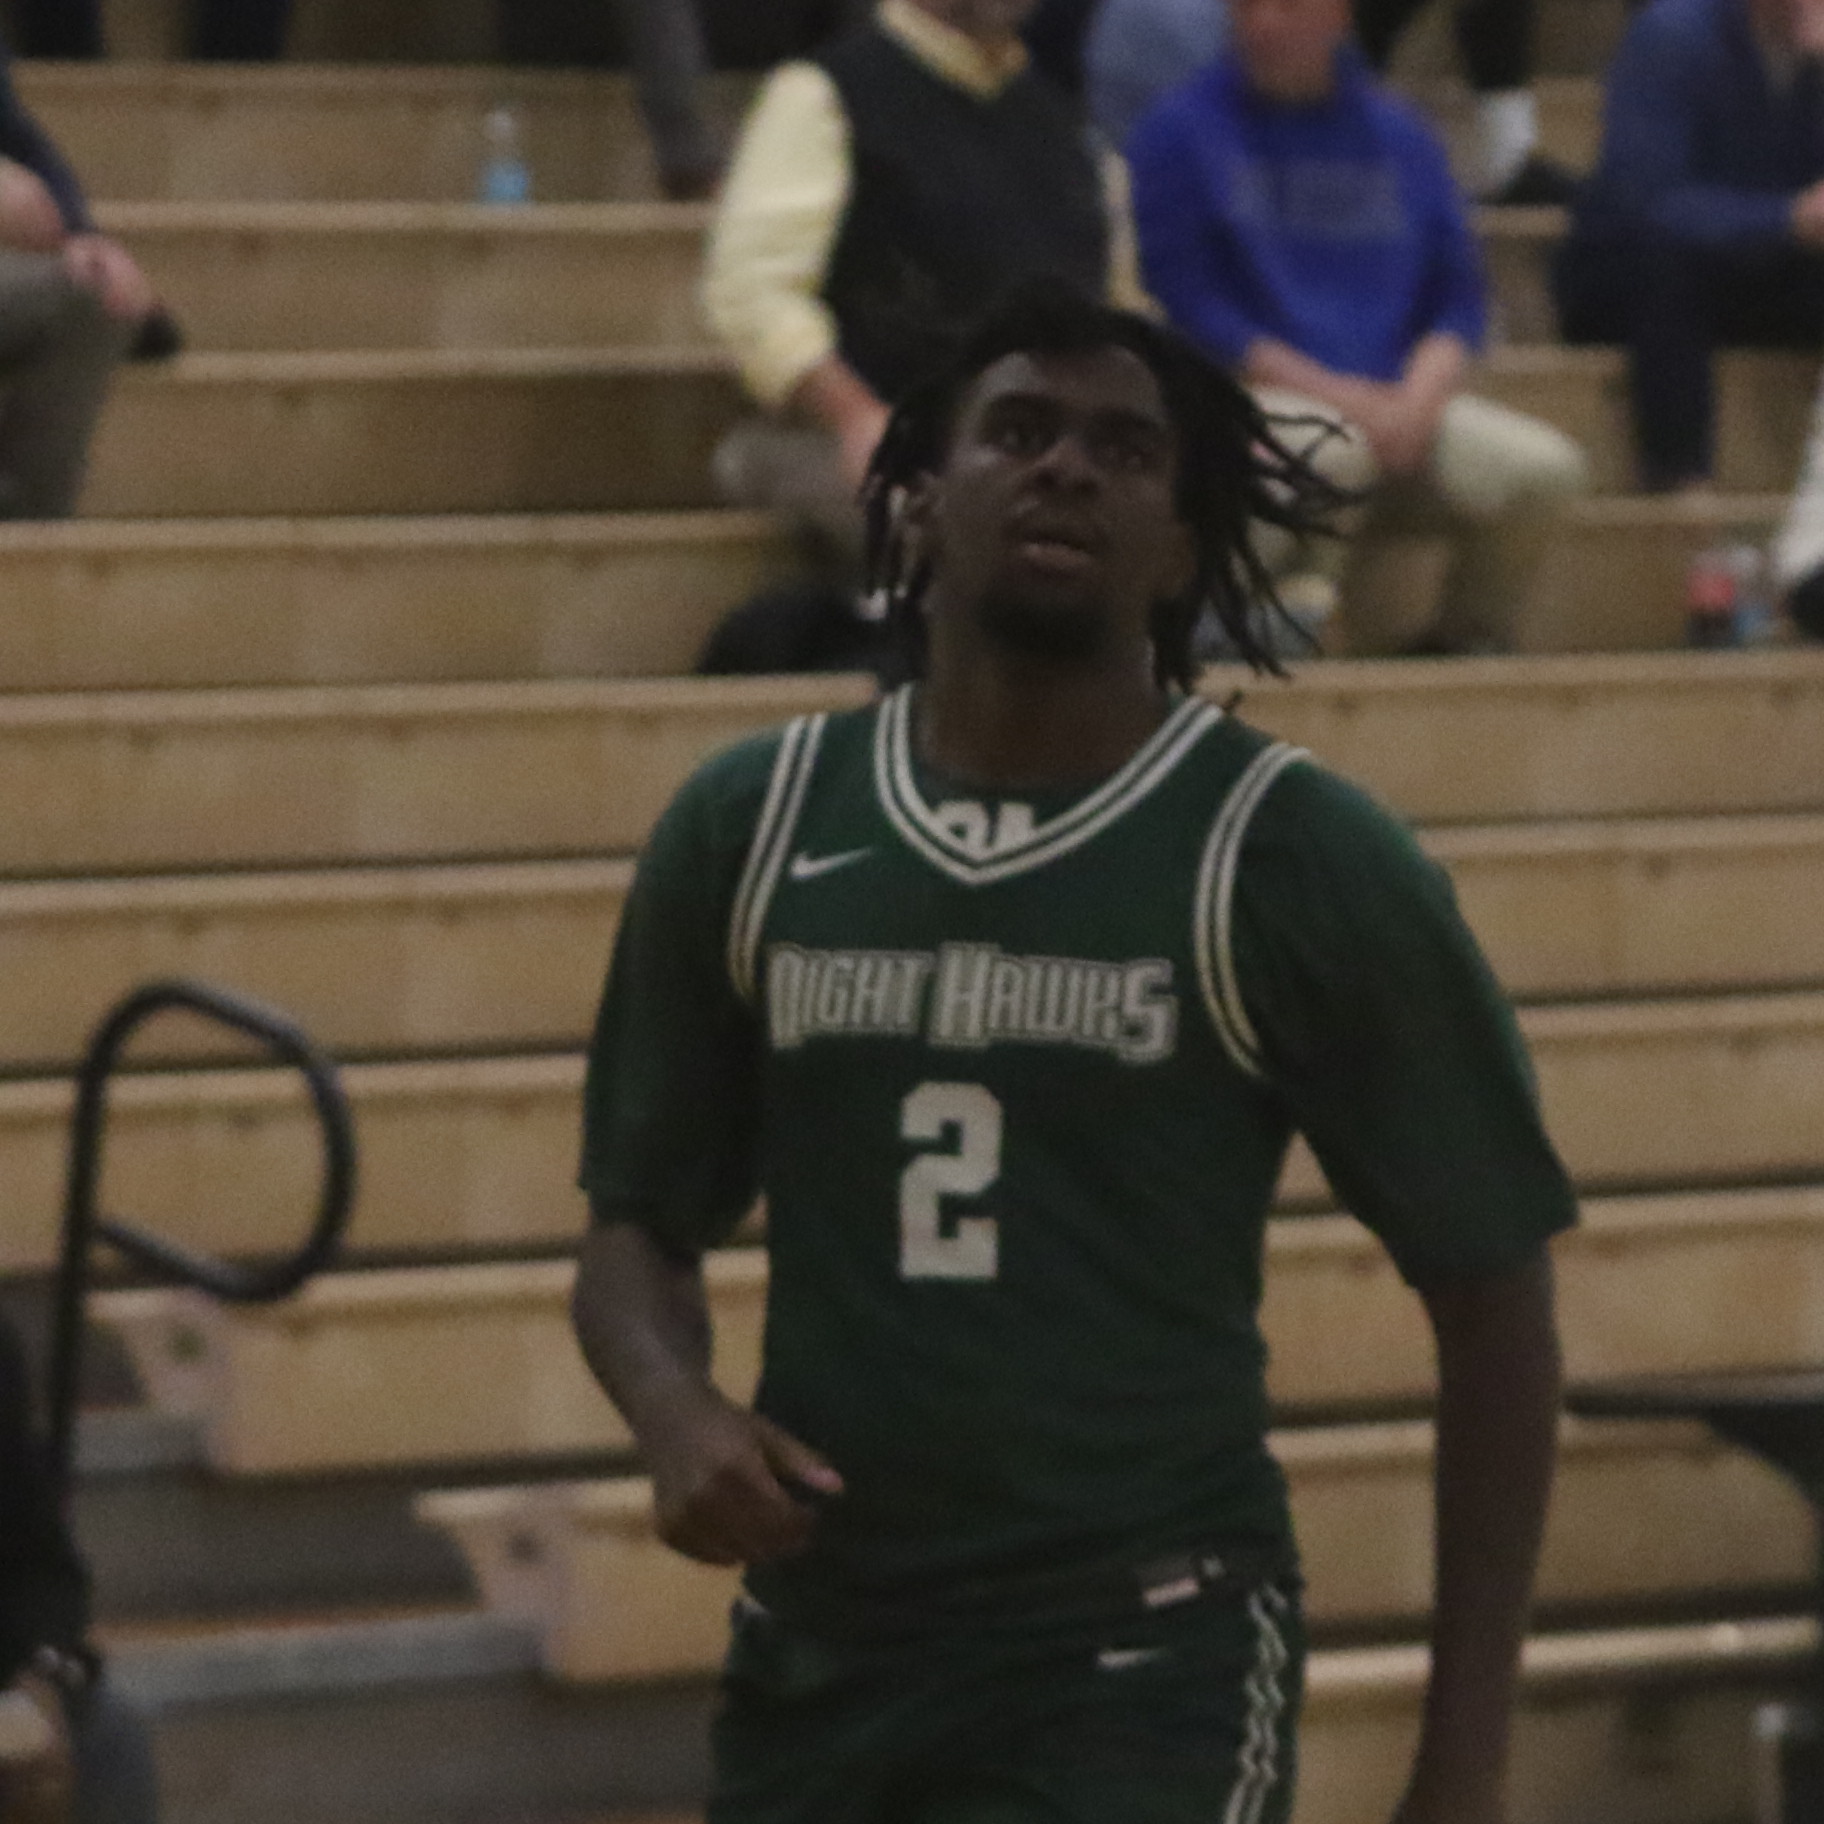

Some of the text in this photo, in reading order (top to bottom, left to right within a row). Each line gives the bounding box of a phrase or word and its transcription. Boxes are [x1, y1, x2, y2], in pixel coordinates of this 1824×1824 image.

[768, 940, 1179, 1064] NIGHT HAWKS
[901, 1081, 1001, 1279] 2
